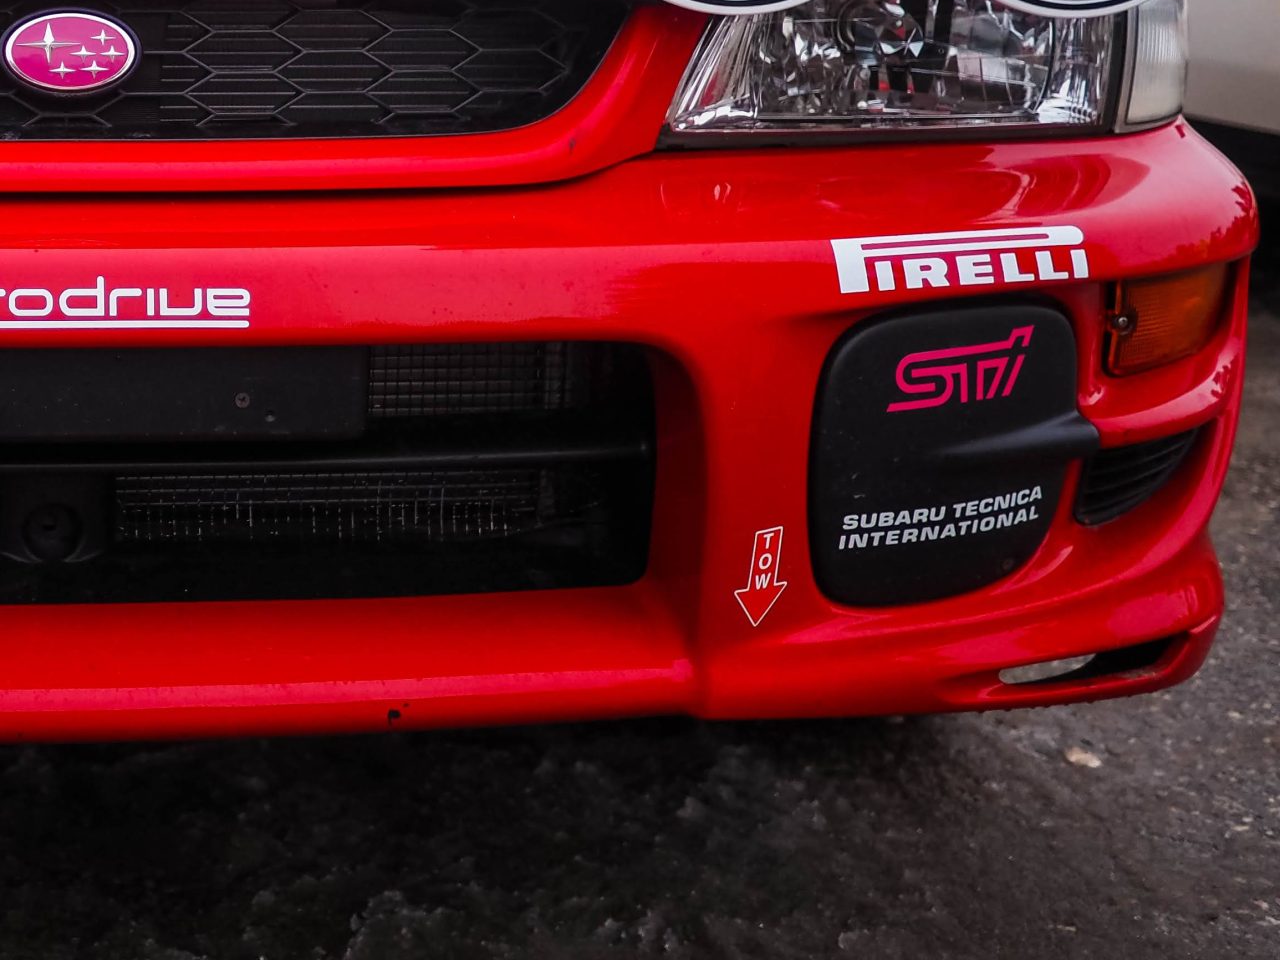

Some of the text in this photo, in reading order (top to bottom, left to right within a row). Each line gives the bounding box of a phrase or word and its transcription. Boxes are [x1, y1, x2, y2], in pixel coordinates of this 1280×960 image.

[830, 225, 1090, 294] PIRELLI
[838, 506, 1039, 551] INTERNATIONAL
[842, 486, 1043, 531] SUBARU TECNICA
[754, 532, 776, 590] TOW
